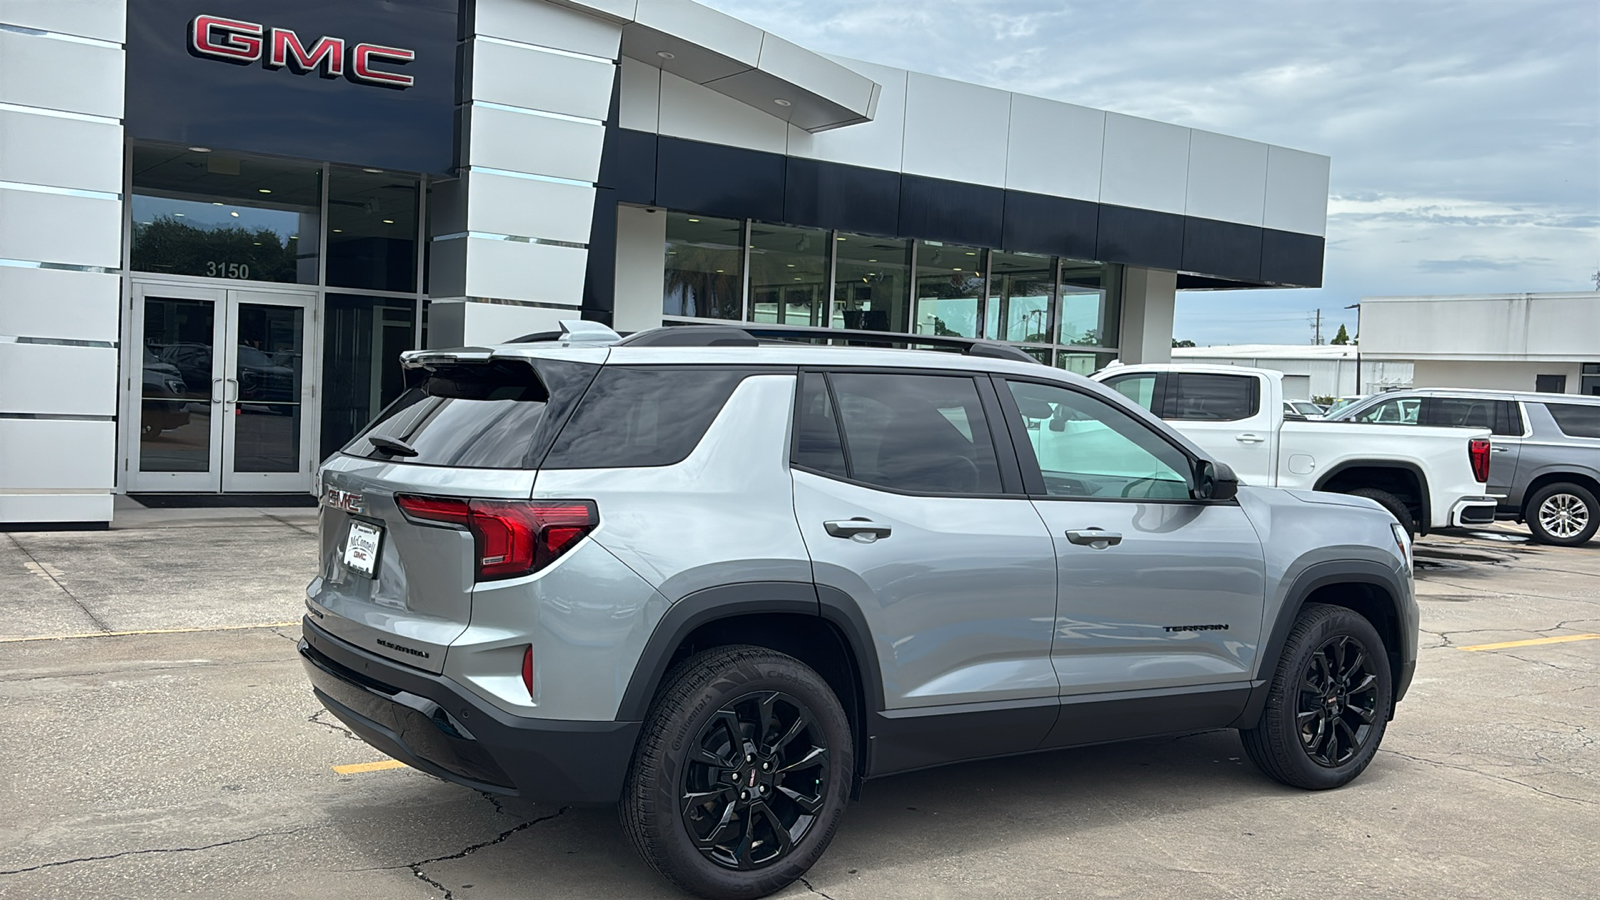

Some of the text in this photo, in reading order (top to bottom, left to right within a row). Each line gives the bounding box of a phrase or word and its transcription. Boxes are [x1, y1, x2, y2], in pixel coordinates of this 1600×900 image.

[190, 14, 415, 87] GMC
[206, 261, 250, 280] 3150
[328, 489, 364, 514] GMC
[1162, 623, 1230, 633] TERRAIN
